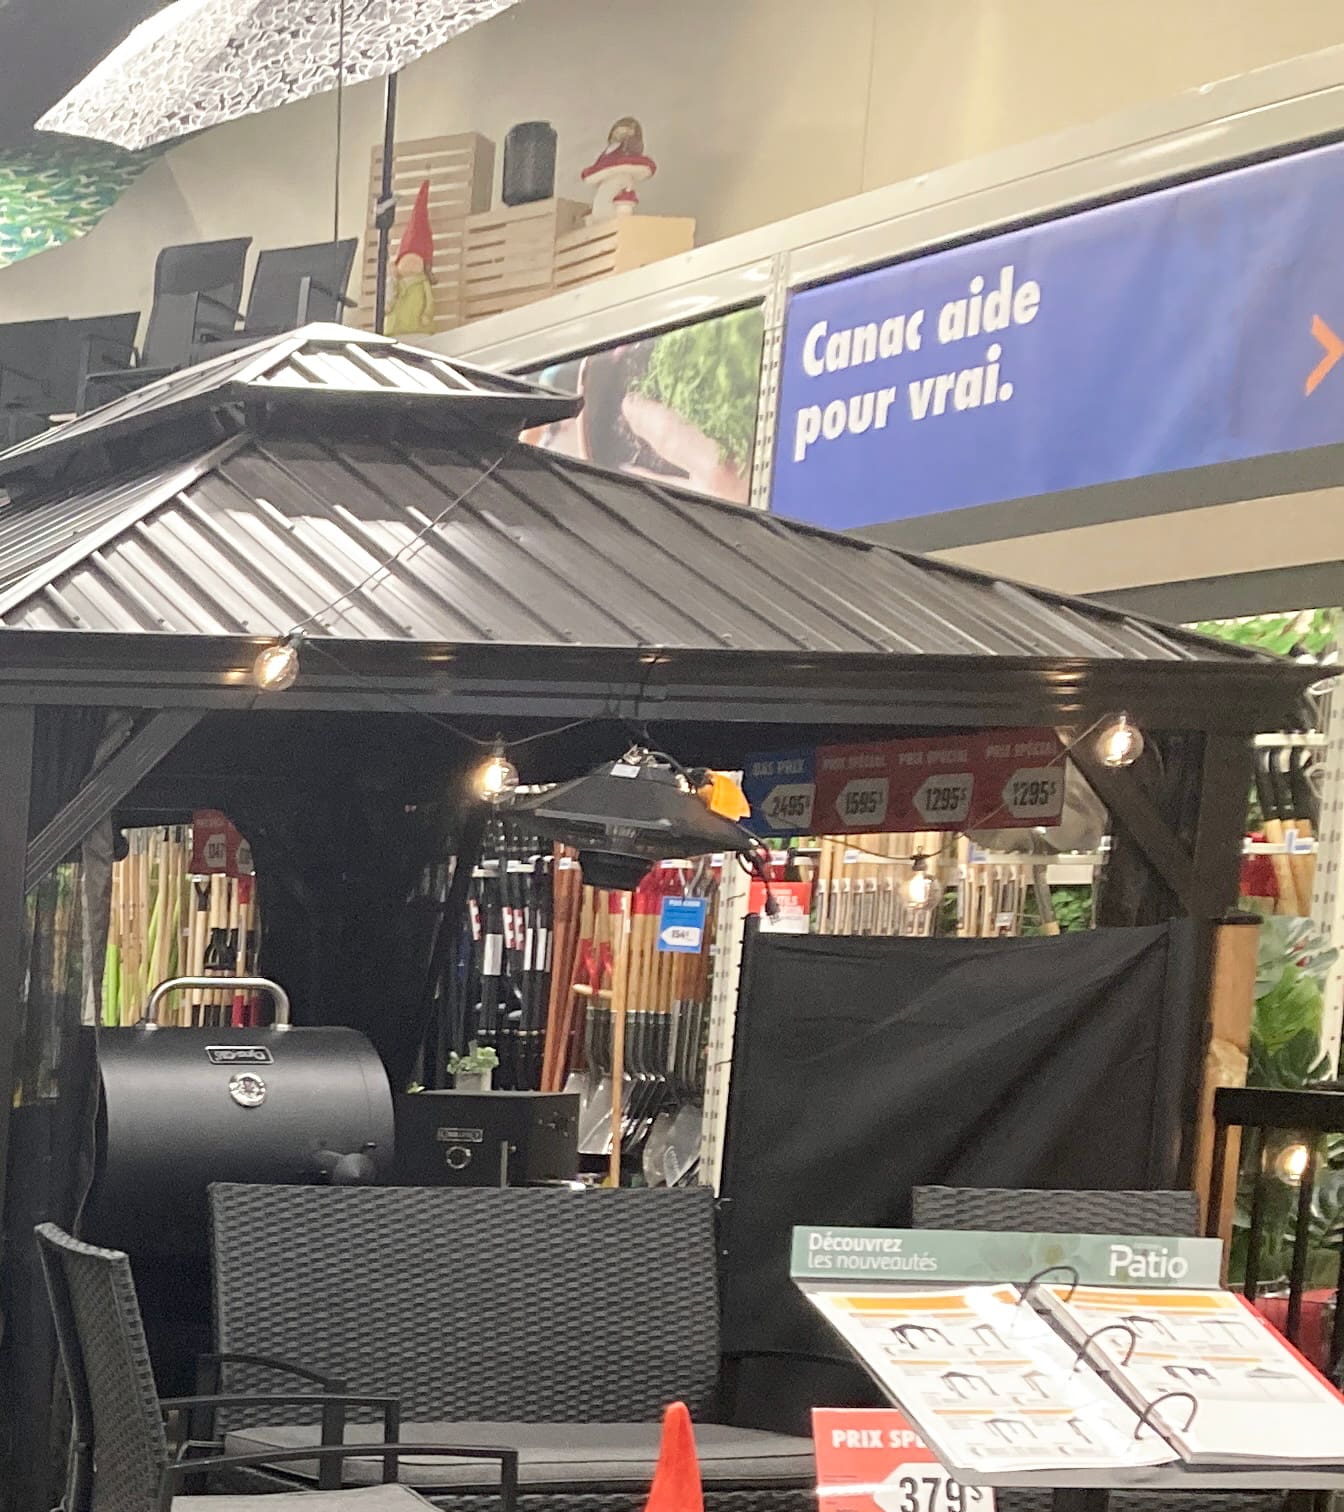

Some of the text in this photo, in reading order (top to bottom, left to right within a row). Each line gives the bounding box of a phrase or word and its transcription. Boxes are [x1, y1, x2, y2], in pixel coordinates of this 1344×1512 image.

[802, 264, 1042, 379] Canac aide
[793, 343, 1014, 464] pour vrai.
[808, 1231, 903, 1253] Découvrez
[807, 1252, 938, 1272] les nouveautés
[1108, 1244, 1189, 1280] Patio
[831, 1429, 884, 1449] PRIX
